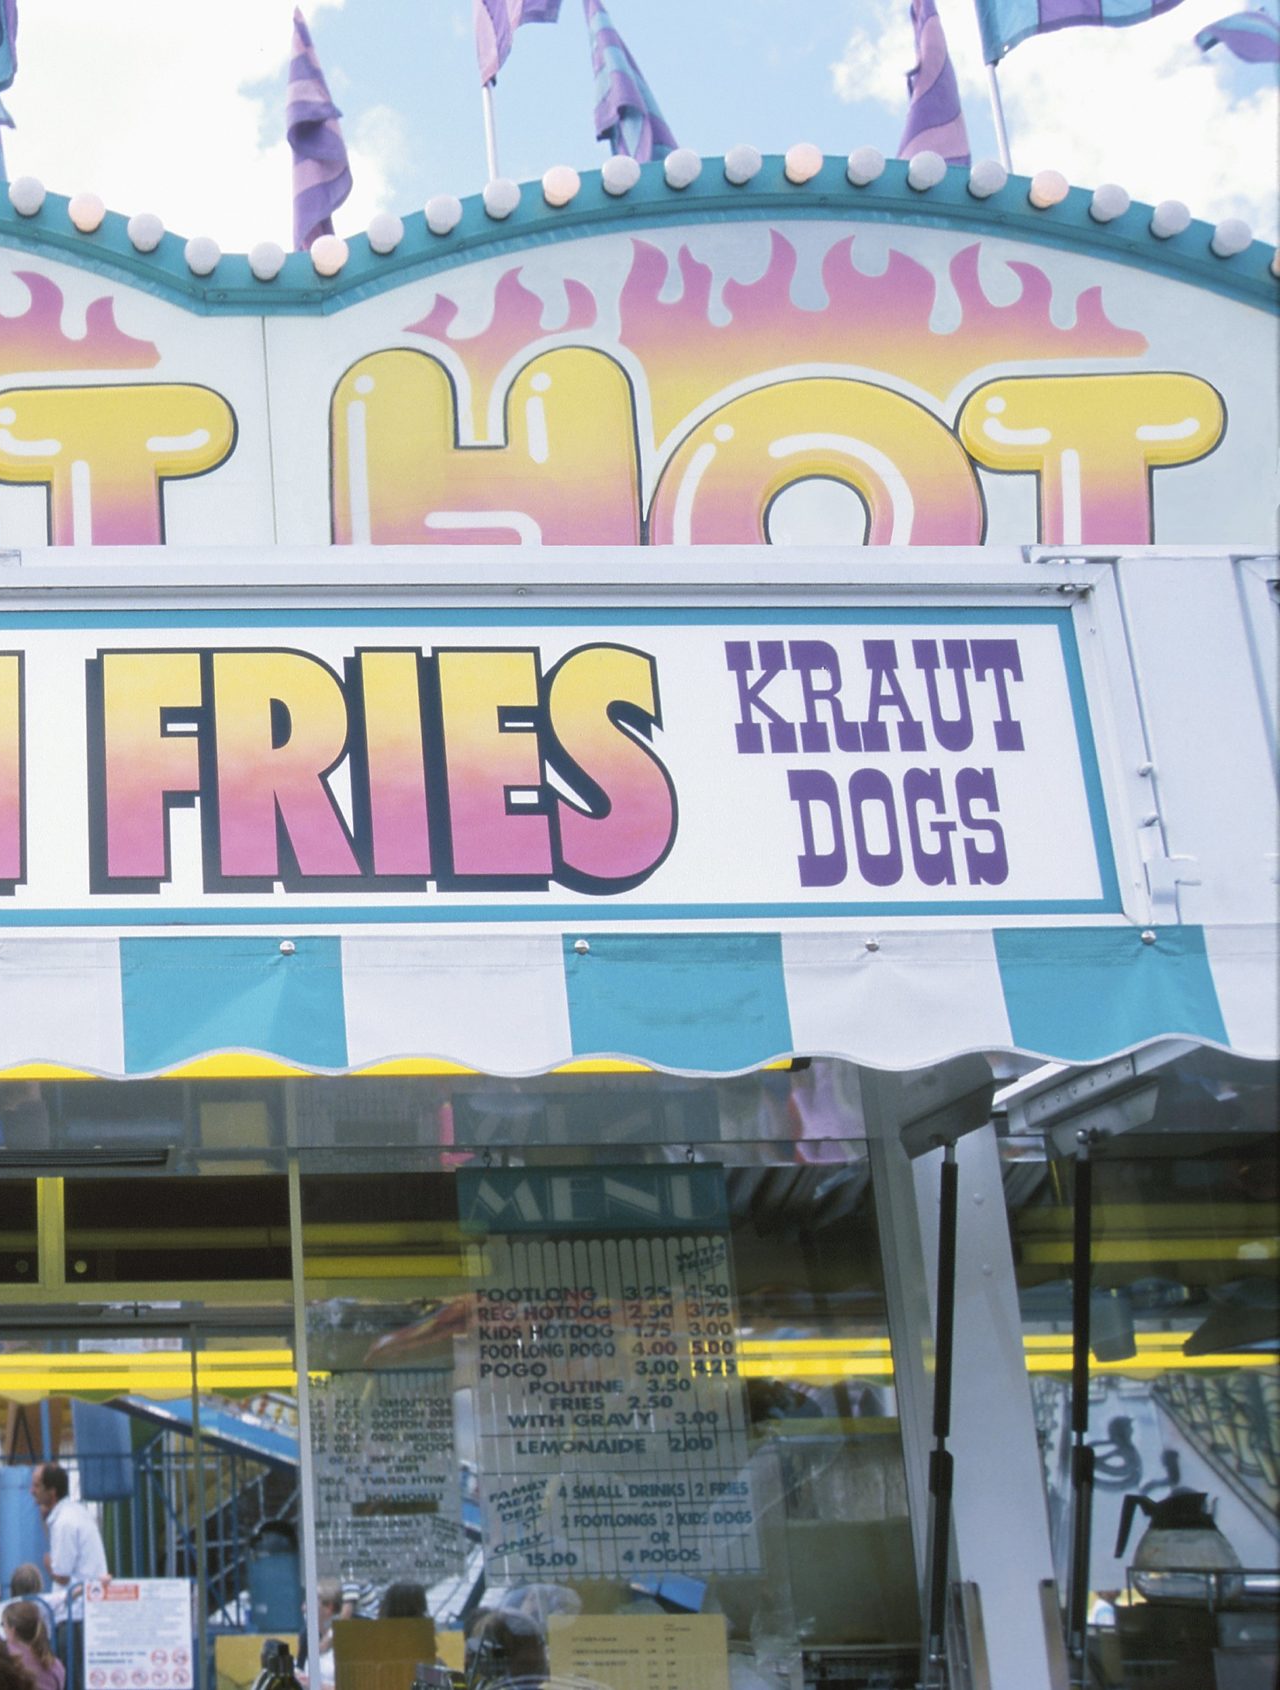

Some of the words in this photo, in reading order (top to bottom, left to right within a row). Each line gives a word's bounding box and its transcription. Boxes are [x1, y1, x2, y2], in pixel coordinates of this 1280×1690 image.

[329, 345, 1228, 545] HOT
[725, 639, 1025, 753] KRAUT
[85, 642, 680, 896] FRIES
[787, 767, 1009, 887] DOGS
[472, 1174, 721, 1222] MENU
[477, 1286, 597, 1301] FOOTLONG
[478, 1306, 516, 1321] REG
[524, 1304, 611, 1320] HOTDOG
[630, 1304, 673, 1318] 2.50
[688, 1303, 729, 1317] 3.75
[479, 1325, 522, 1340] KIDS
[530, 1323, 614, 1339] HOTDOG
[635, 1322, 670, 1337] 1.75
[688, 1322, 732, 1336] 3.00
[480, 1342, 564, 1360] FOOTLONG
[570, 1341, 615, 1357] POGO
[633, 1341, 677, 1356] 4.00
[692, 1340, 734, 1355] 5.00
[480, 1362, 547, 1378] POGO
[635, 1361, 679, 1376] 3.00
[693, 1360, 736, 1375] 4.25
[529, 1380, 624, 1396] POUTINE
[647, 1379, 690, 1393] 3.50
[549, 1396, 605, 1411] FRIES
[628, 1395, 673, 1409] 2.50
[507, 1413, 564, 1428] WITH
[574, 1411, 652, 1428] GRAVY
[675, 1411, 718, 1425] 3.00
[517, 1438, 647, 1455] LEMONAIDE
[671, 1437, 714, 1452] 2.00
[489, 1479, 548, 1503] FAMILY
[558, 1485, 567, 1498] 4
[573, 1484, 624, 1499] SMALL
[628, 1483, 686, 1498] DRINKS
[696, 1483, 704, 1497] 2
[710, 1481, 749, 1496] FRIES
[497, 1491, 545, 1511] MEAL
[642, 1501, 673, 1509] AND
[502, 1504, 545, 1522] DEAL
[561, 1515, 569, 1528] 2
[574, 1512, 657, 1528] FOOTLONGS
[666, 1513, 674, 1527] 2
[677, 1512, 708, 1526] KIDS
[713, 1511, 753, 1525] DOGS
[494, 1532, 544, 1554] ONLY
[650, 1532, 670, 1544] OR
[525, 1552, 578, 1567] 15.00
[623, 1550, 634, 1563] 4
[640, 1549, 702, 1563] POGOS
